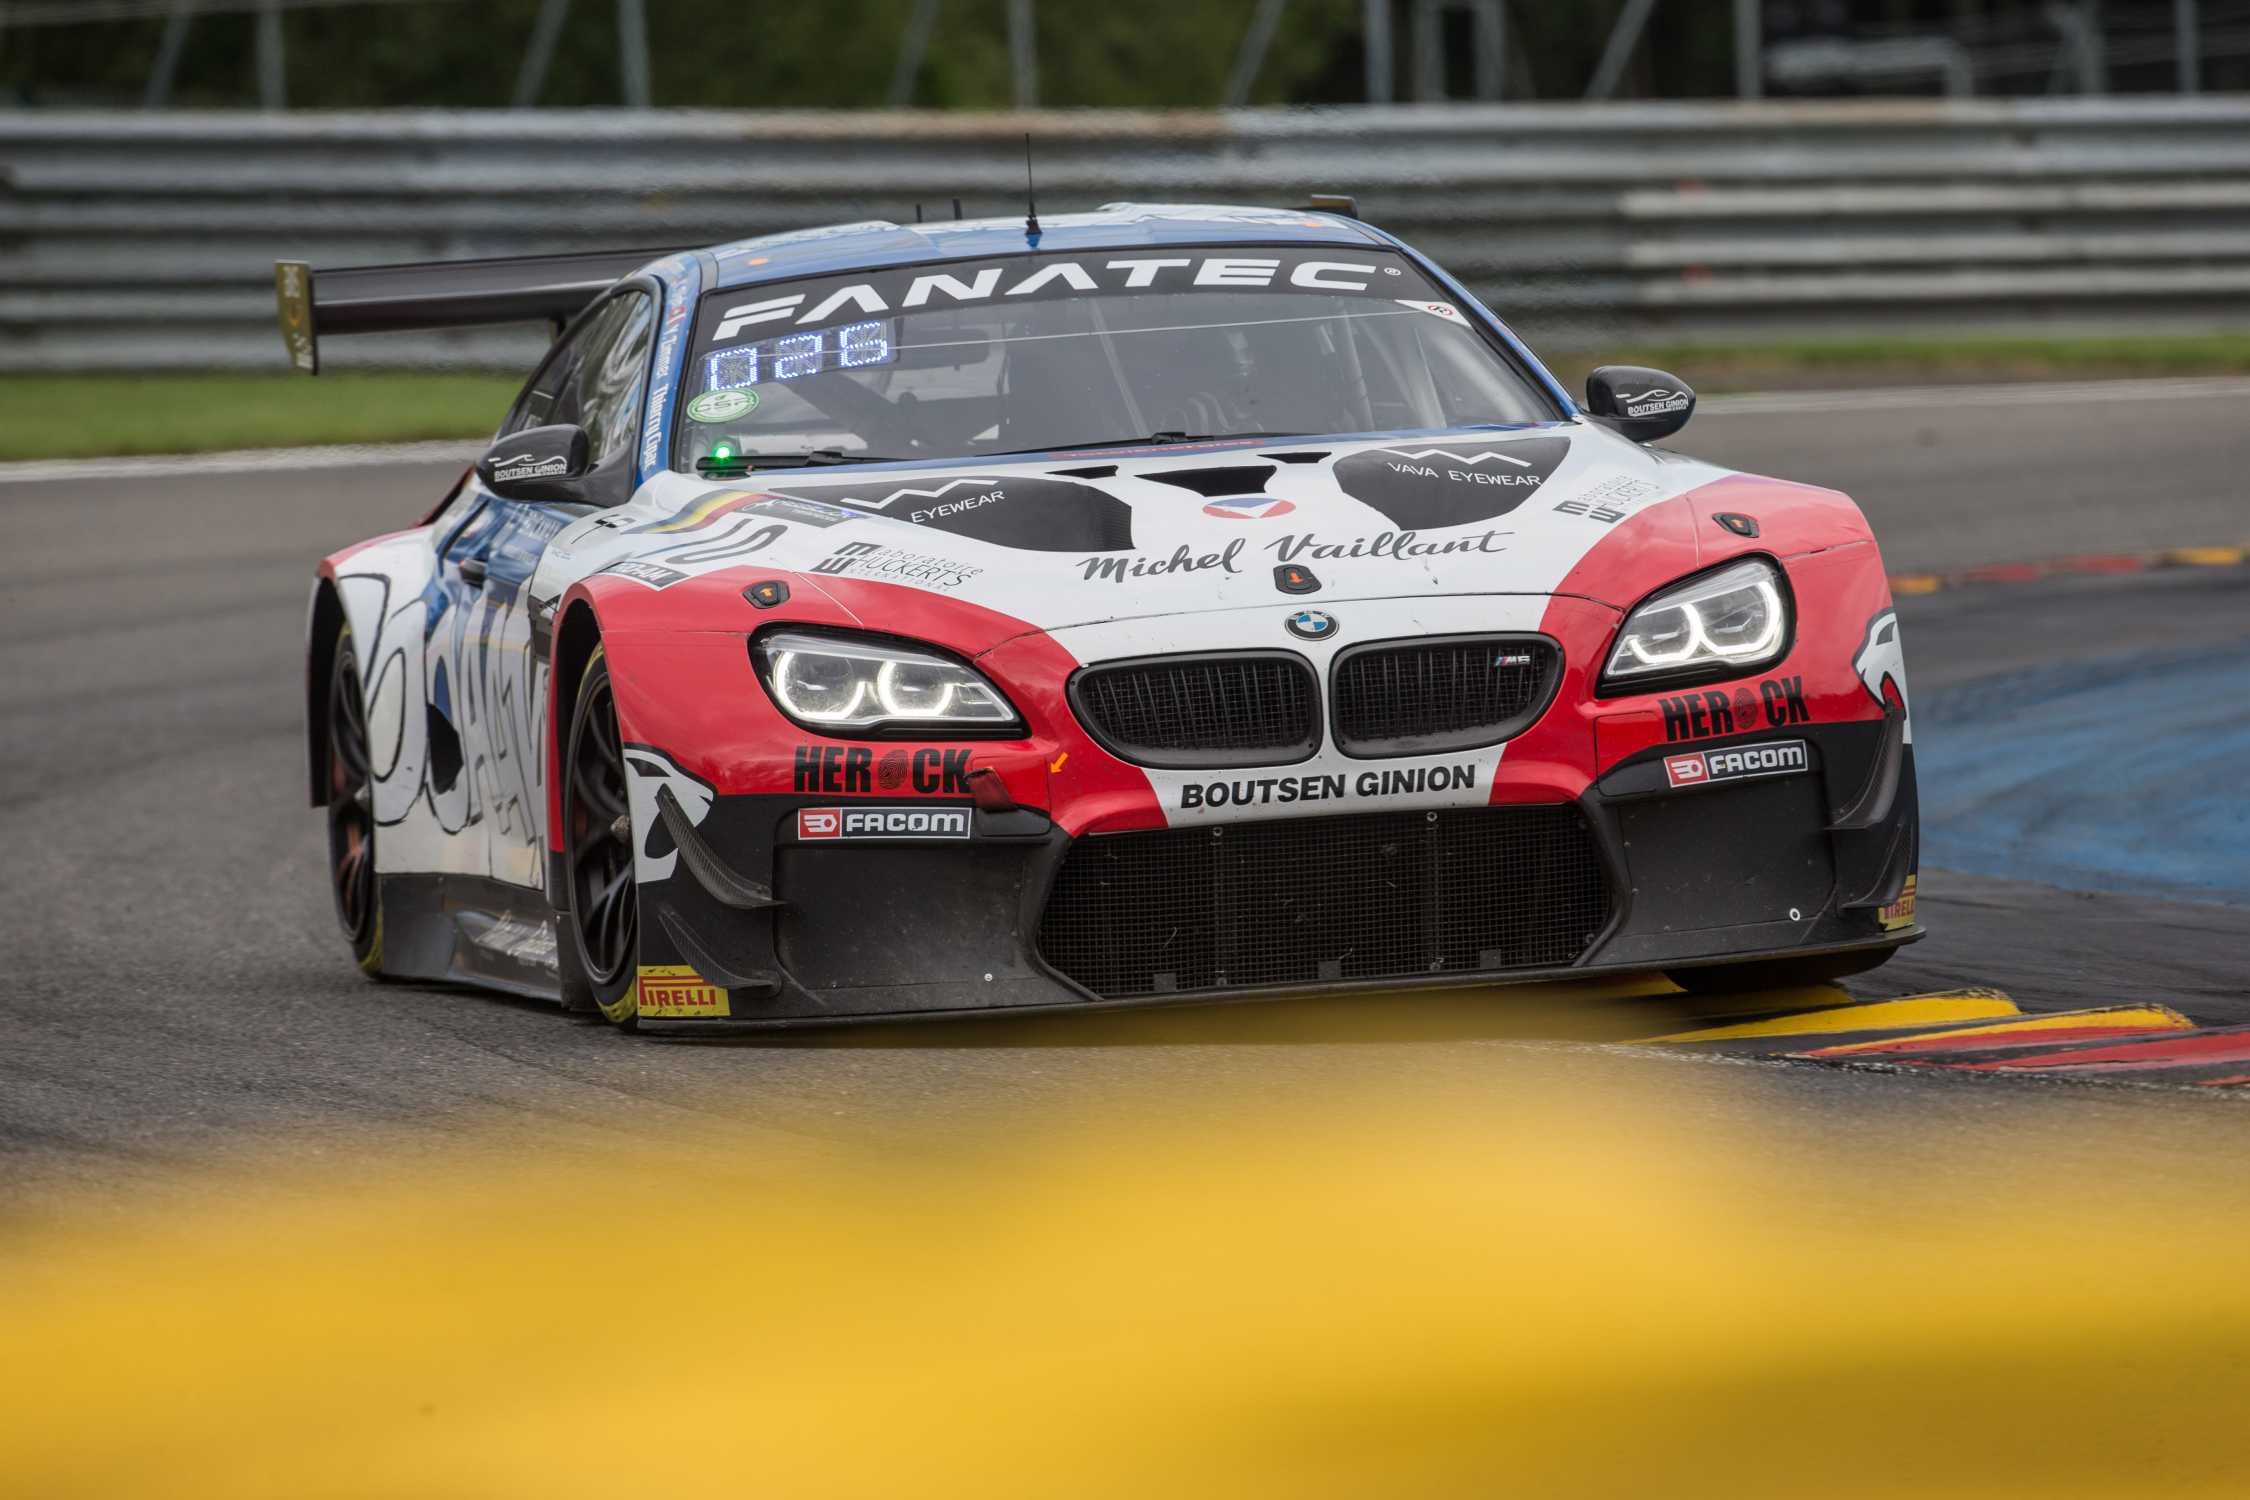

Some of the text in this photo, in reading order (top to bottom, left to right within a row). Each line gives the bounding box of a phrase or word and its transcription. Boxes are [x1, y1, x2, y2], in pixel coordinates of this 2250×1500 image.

[712, 258, 1377, 342] FANATEC
[1387, 462, 1542, 487] VAVA EYEWEAR
[910, 491, 1006, 523] EYEWEAR
[1076, 529, 1516, 584] Michel Vaillant
[1709, 746, 1804, 775] FACOM
[1180, 765, 1476, 809] BOUTSEN GINION
[845, 813, 965, 832] FACOM
[639, 975, 717, 1007] PIRELLI
